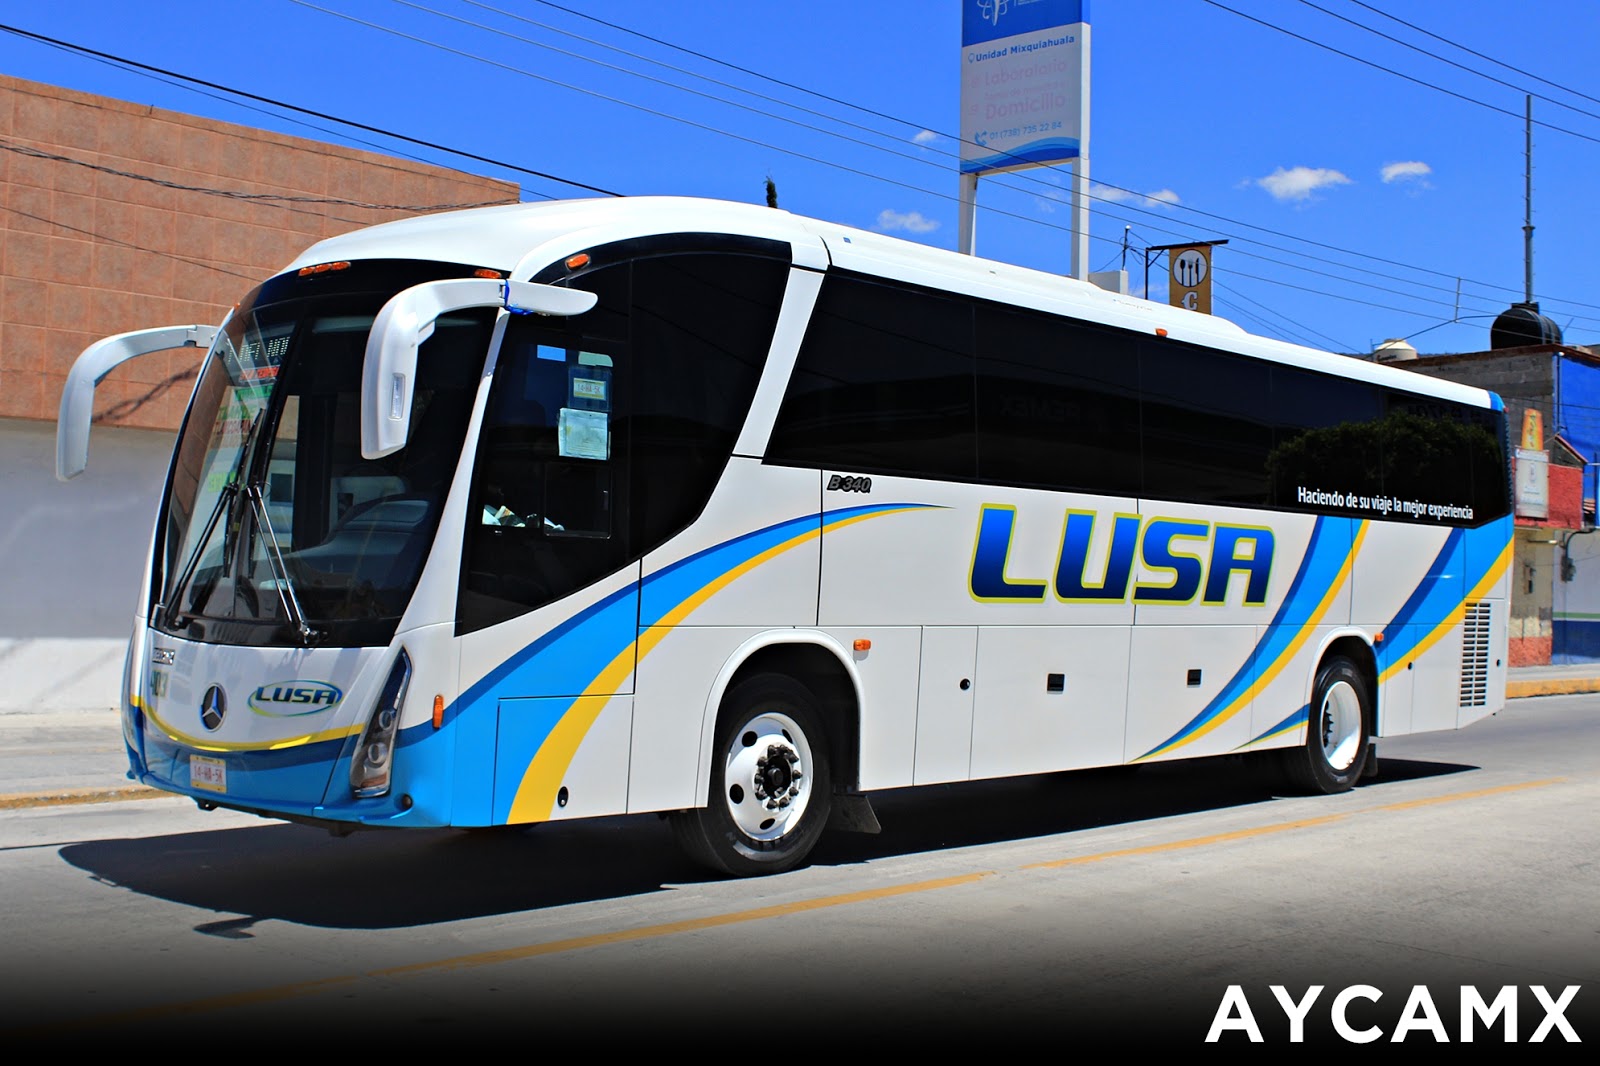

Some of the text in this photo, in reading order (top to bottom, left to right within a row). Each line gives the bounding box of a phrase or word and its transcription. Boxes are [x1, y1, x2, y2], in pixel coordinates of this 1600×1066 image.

[976, 35, 1075, 62] Unidad Mixquiahuala
[989, 132, 998, 140] 01
[826, 474, 872, 493] B 340
[1298, 486, 1473, 520] Haciendo de su viaje la mejor experiencia
[968, 503, 1275, 607] LUSA
[254, 686, 335, 705] LUSA
